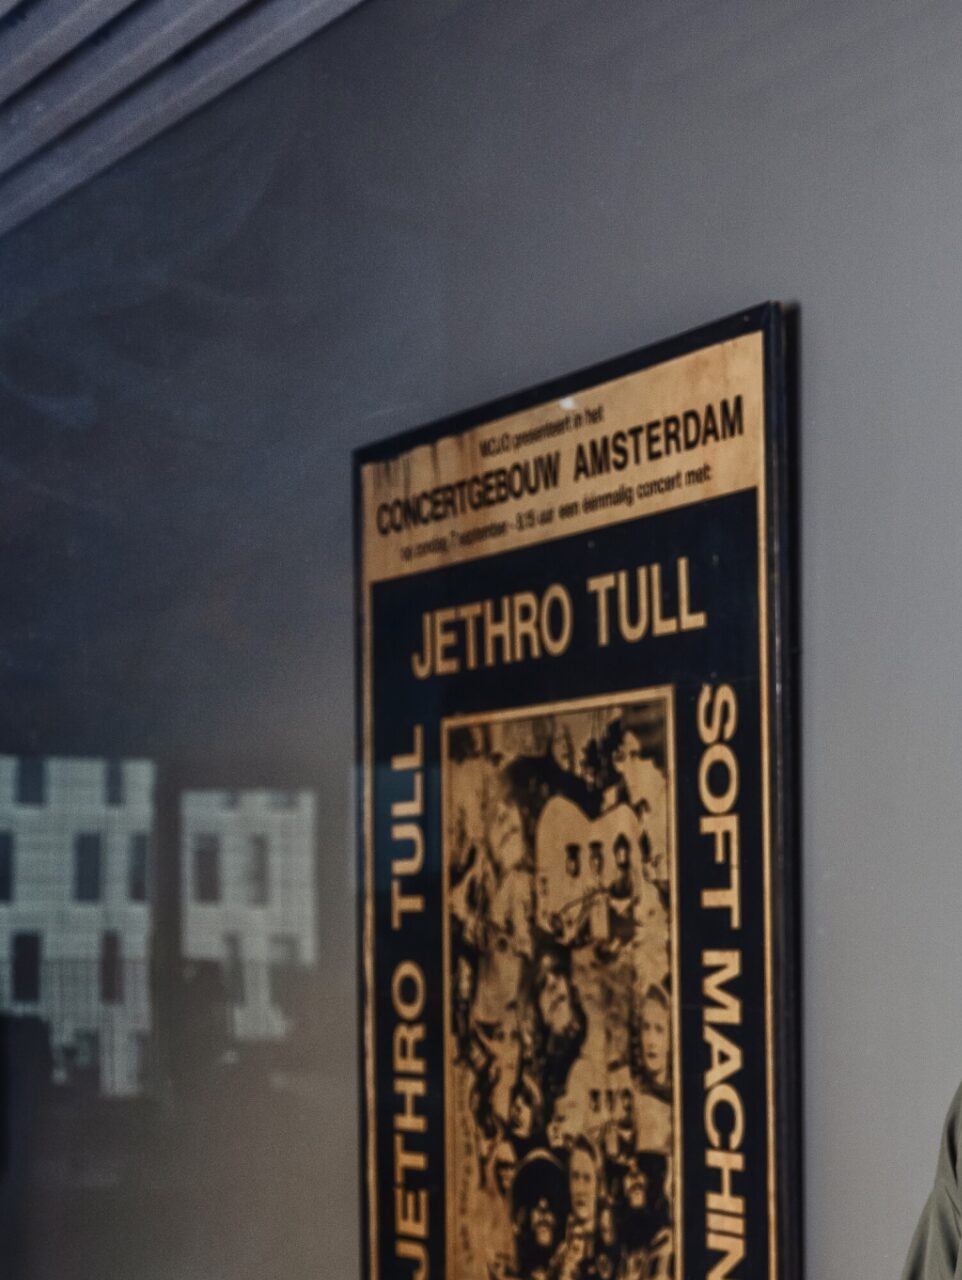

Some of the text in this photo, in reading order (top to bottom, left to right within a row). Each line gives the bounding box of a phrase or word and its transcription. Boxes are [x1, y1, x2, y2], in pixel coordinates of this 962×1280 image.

[376, 395, 744, 537] CONCERTGEBOUW AMSTERDAM
[584, 405, 603, 425] het
[636, 470, 682, 499] concert
[411, 556, 707, 679] JETHRO TULL
[390, 724, 425, 930] TULL
[696, 682, 741, 930] SOFT
